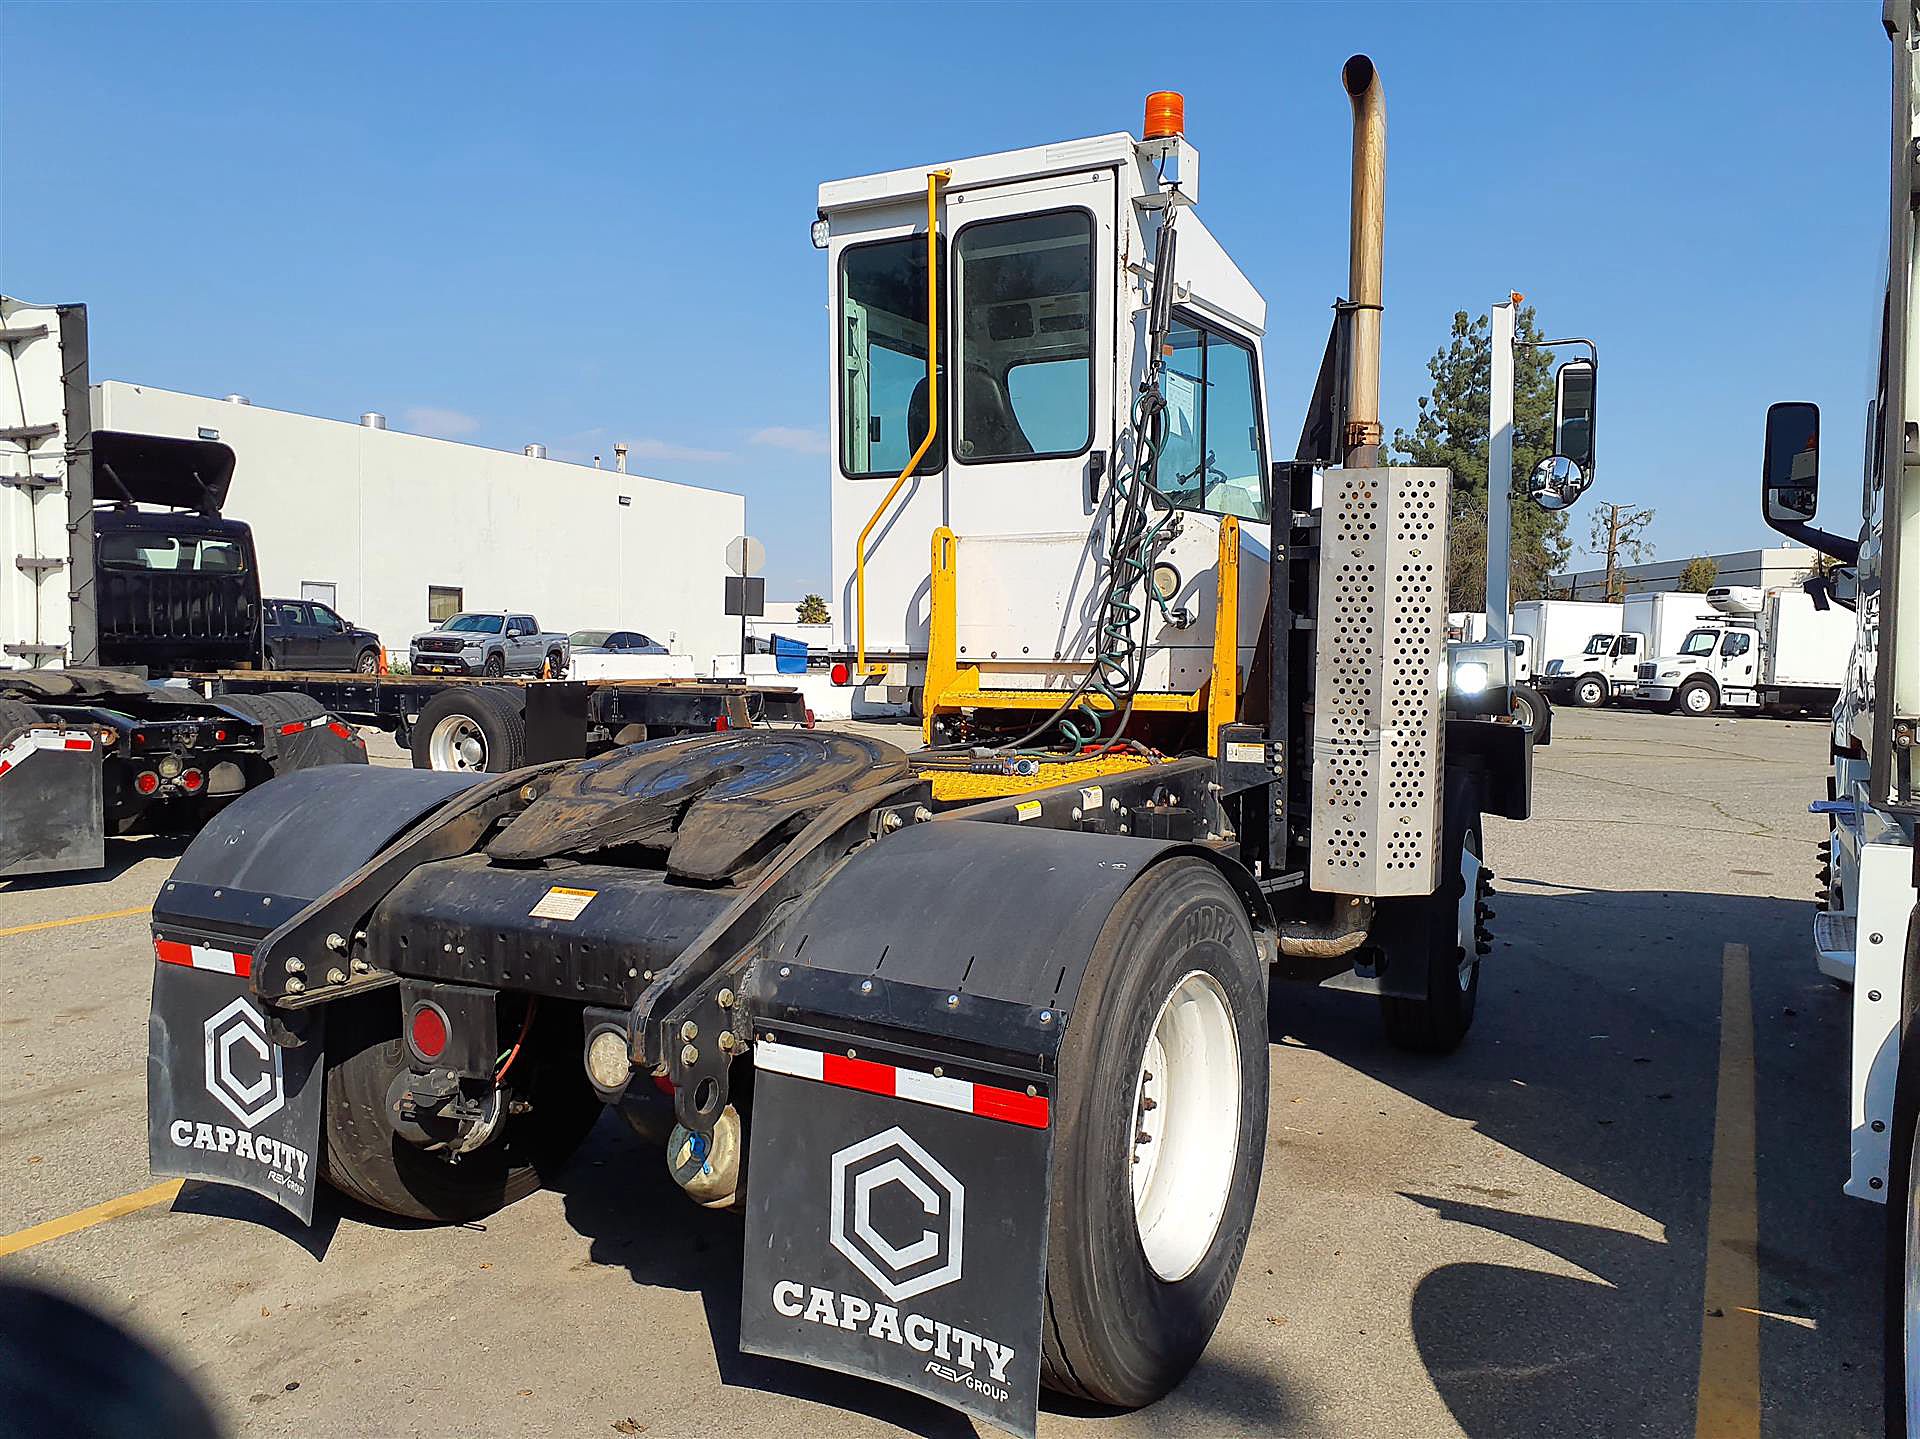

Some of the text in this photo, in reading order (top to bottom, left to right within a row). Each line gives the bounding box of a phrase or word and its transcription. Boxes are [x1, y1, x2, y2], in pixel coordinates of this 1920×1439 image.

[1184, 904, 1236, 949] HDR2
[170, 1119, 309, 1182] CAPACITY
[772, 1279, 1015, 1383] CAPACITY
